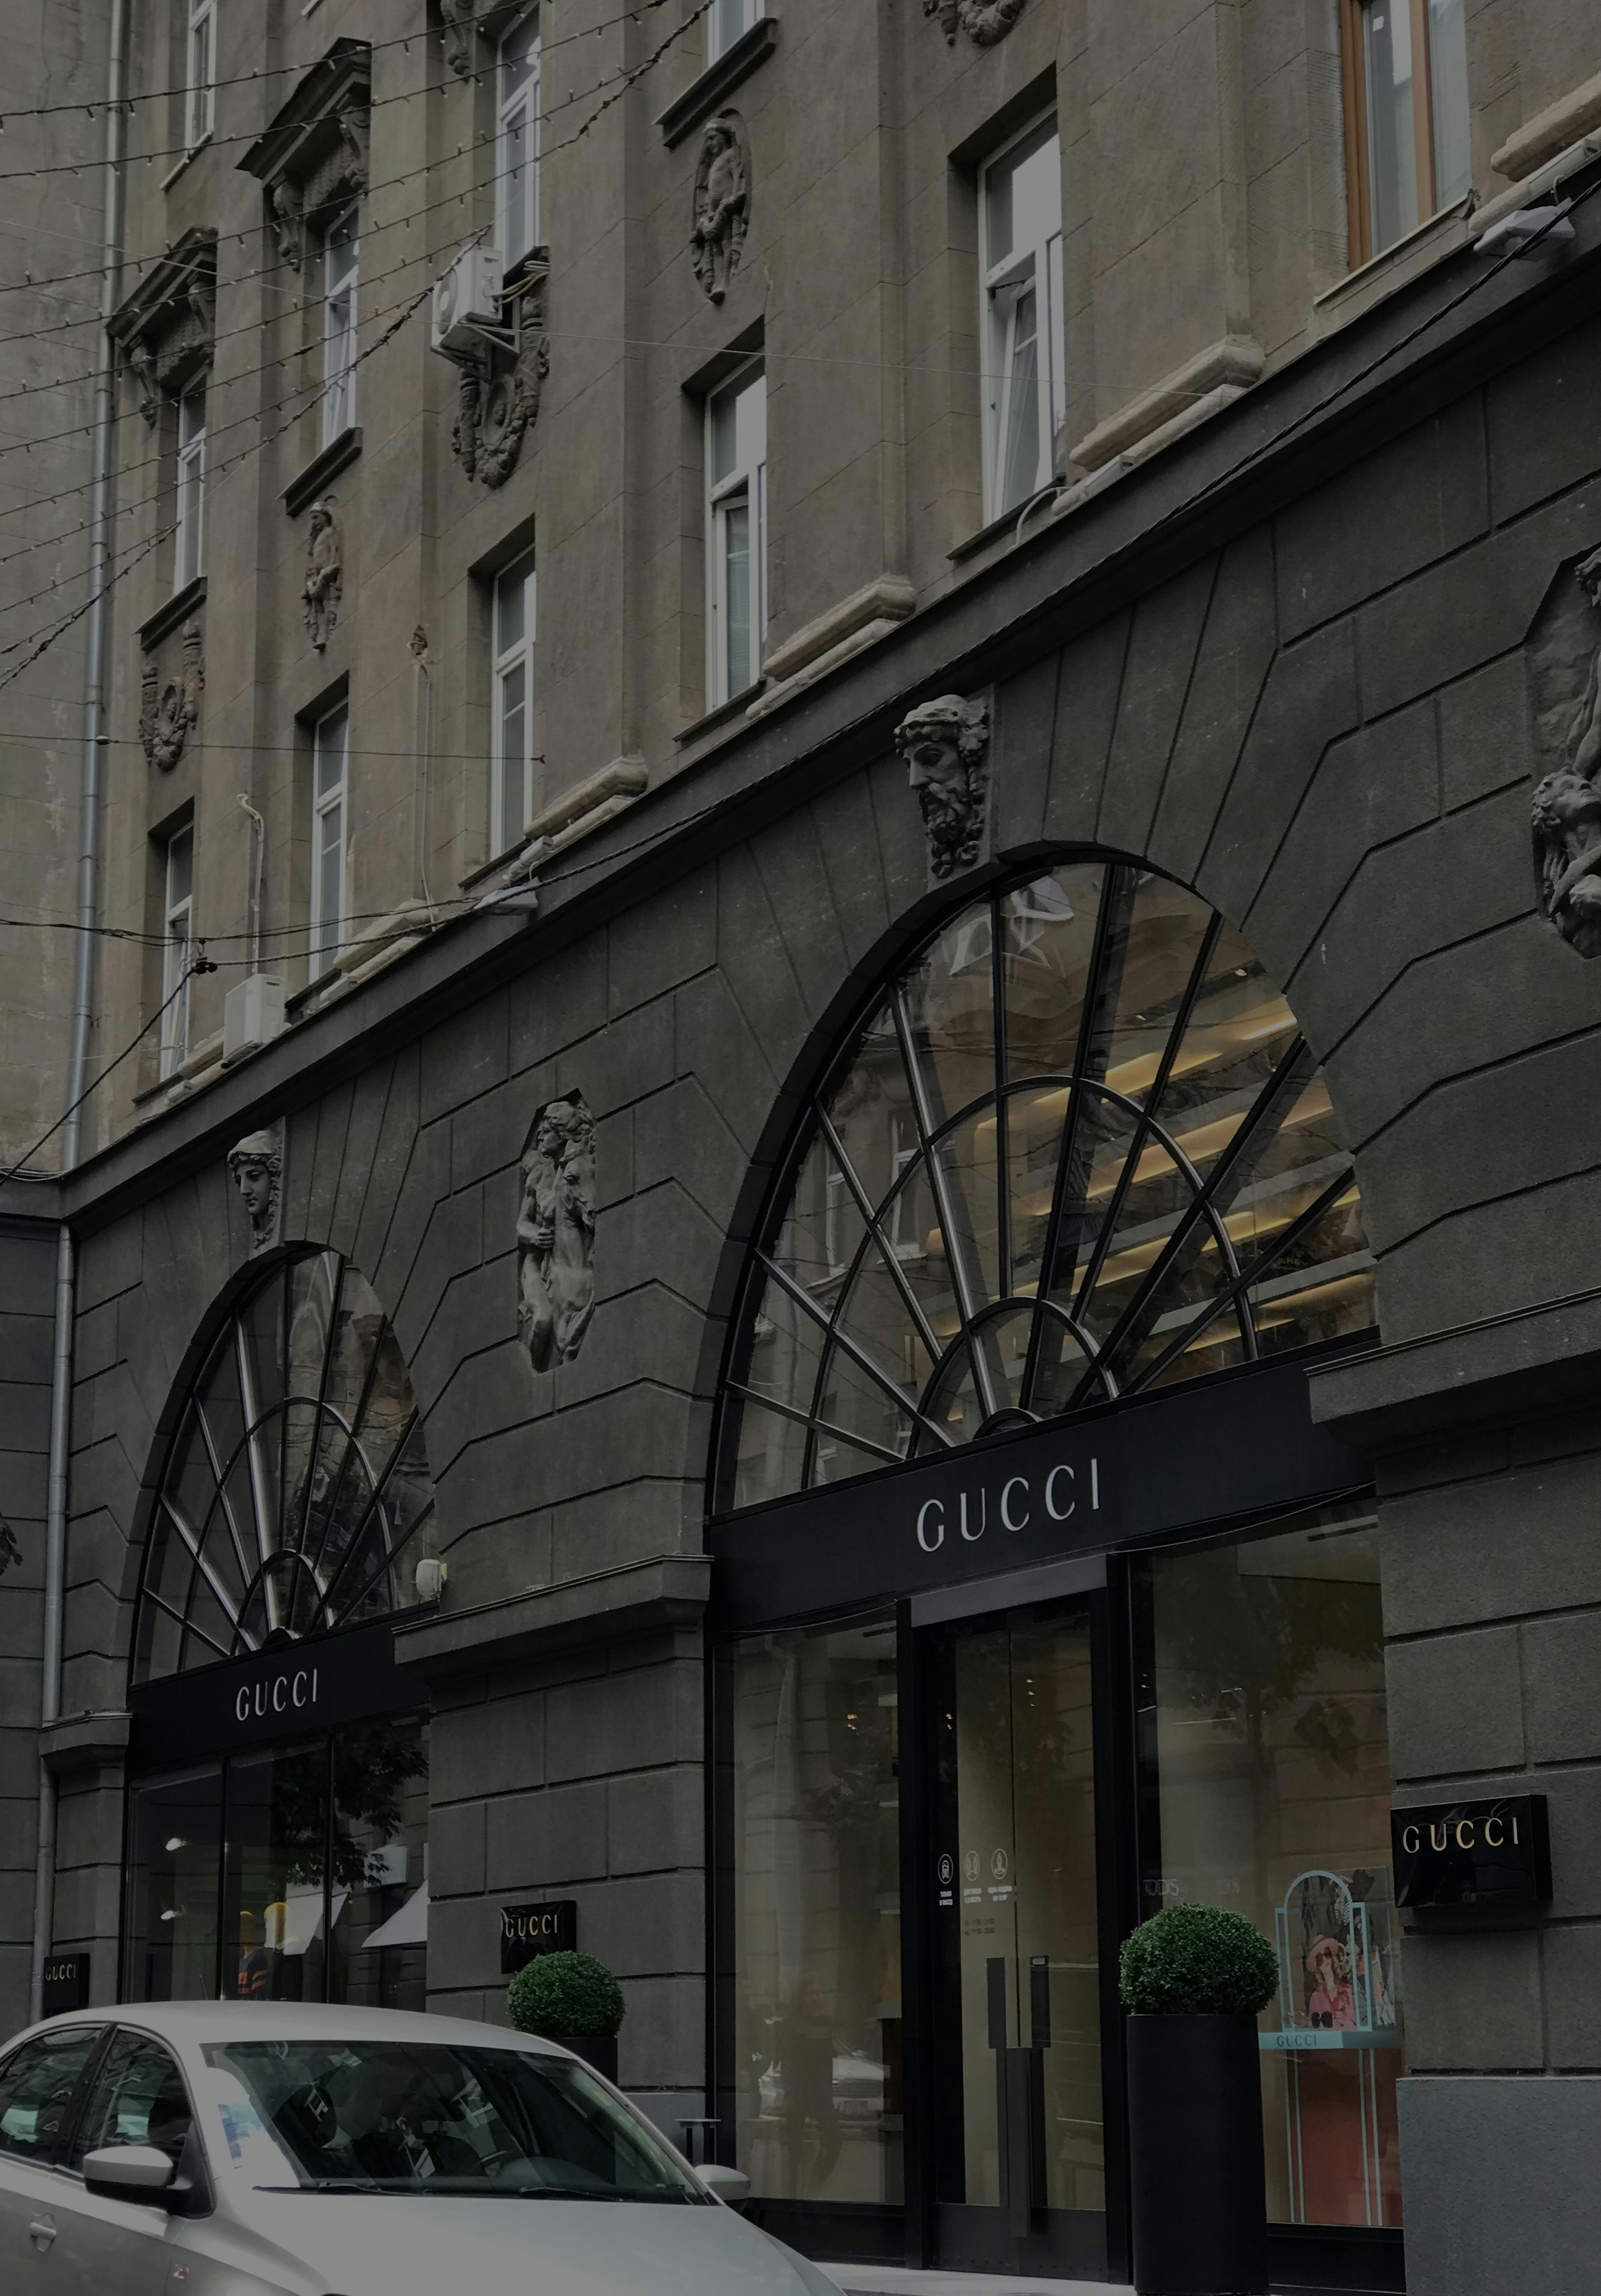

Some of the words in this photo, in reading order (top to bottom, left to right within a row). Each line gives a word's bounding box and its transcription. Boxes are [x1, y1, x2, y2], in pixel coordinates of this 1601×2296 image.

[917, 1458, 1099, 1552] GUCCI
[236, 1668, 317, 1721] GUCCI
[1403, 1817, 1519, 1854] GUCCI
[505, 1914, 558, 1938] GUCCI
[46, 1963, 76, 1982] GUCCI
[1276, 2034, 1317, 2047] GUCCI
